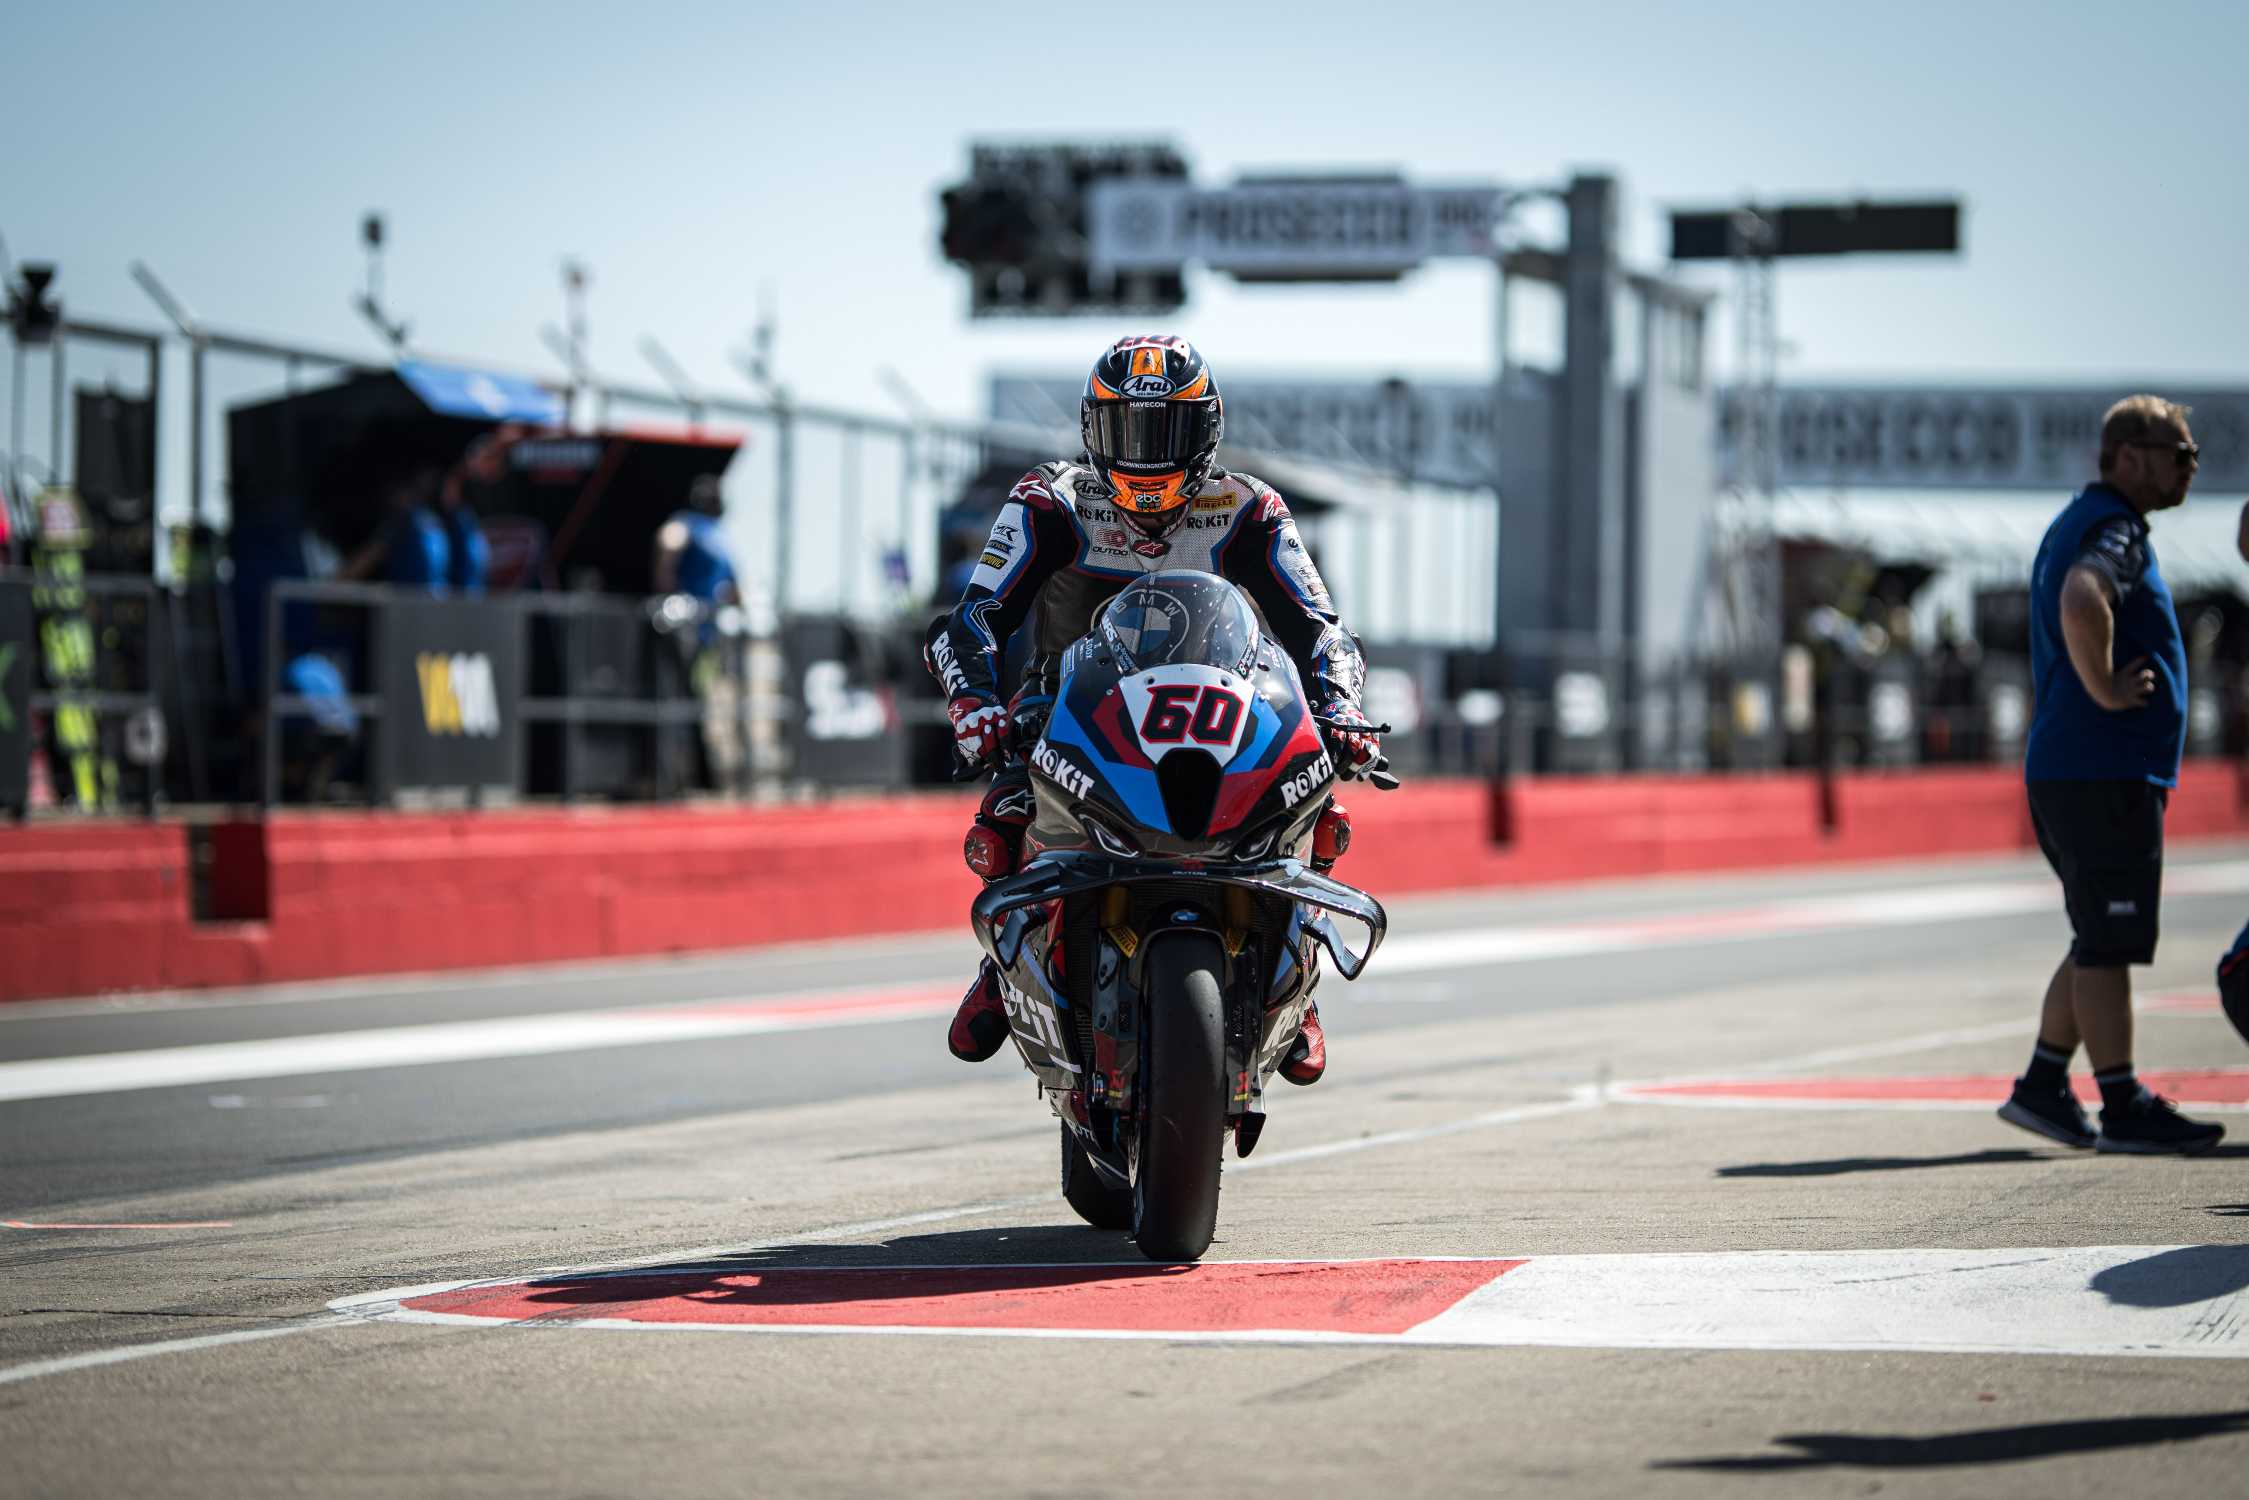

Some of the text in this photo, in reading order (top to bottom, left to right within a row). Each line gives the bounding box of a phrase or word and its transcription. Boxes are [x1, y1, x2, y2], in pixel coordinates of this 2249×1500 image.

[1123, 376, 1168, 392] Arai
[1078, 481, 1103, 494] Ara
[1135, 492, 1161, 502] ebc
[1139, 684, 1245, 746] 60
